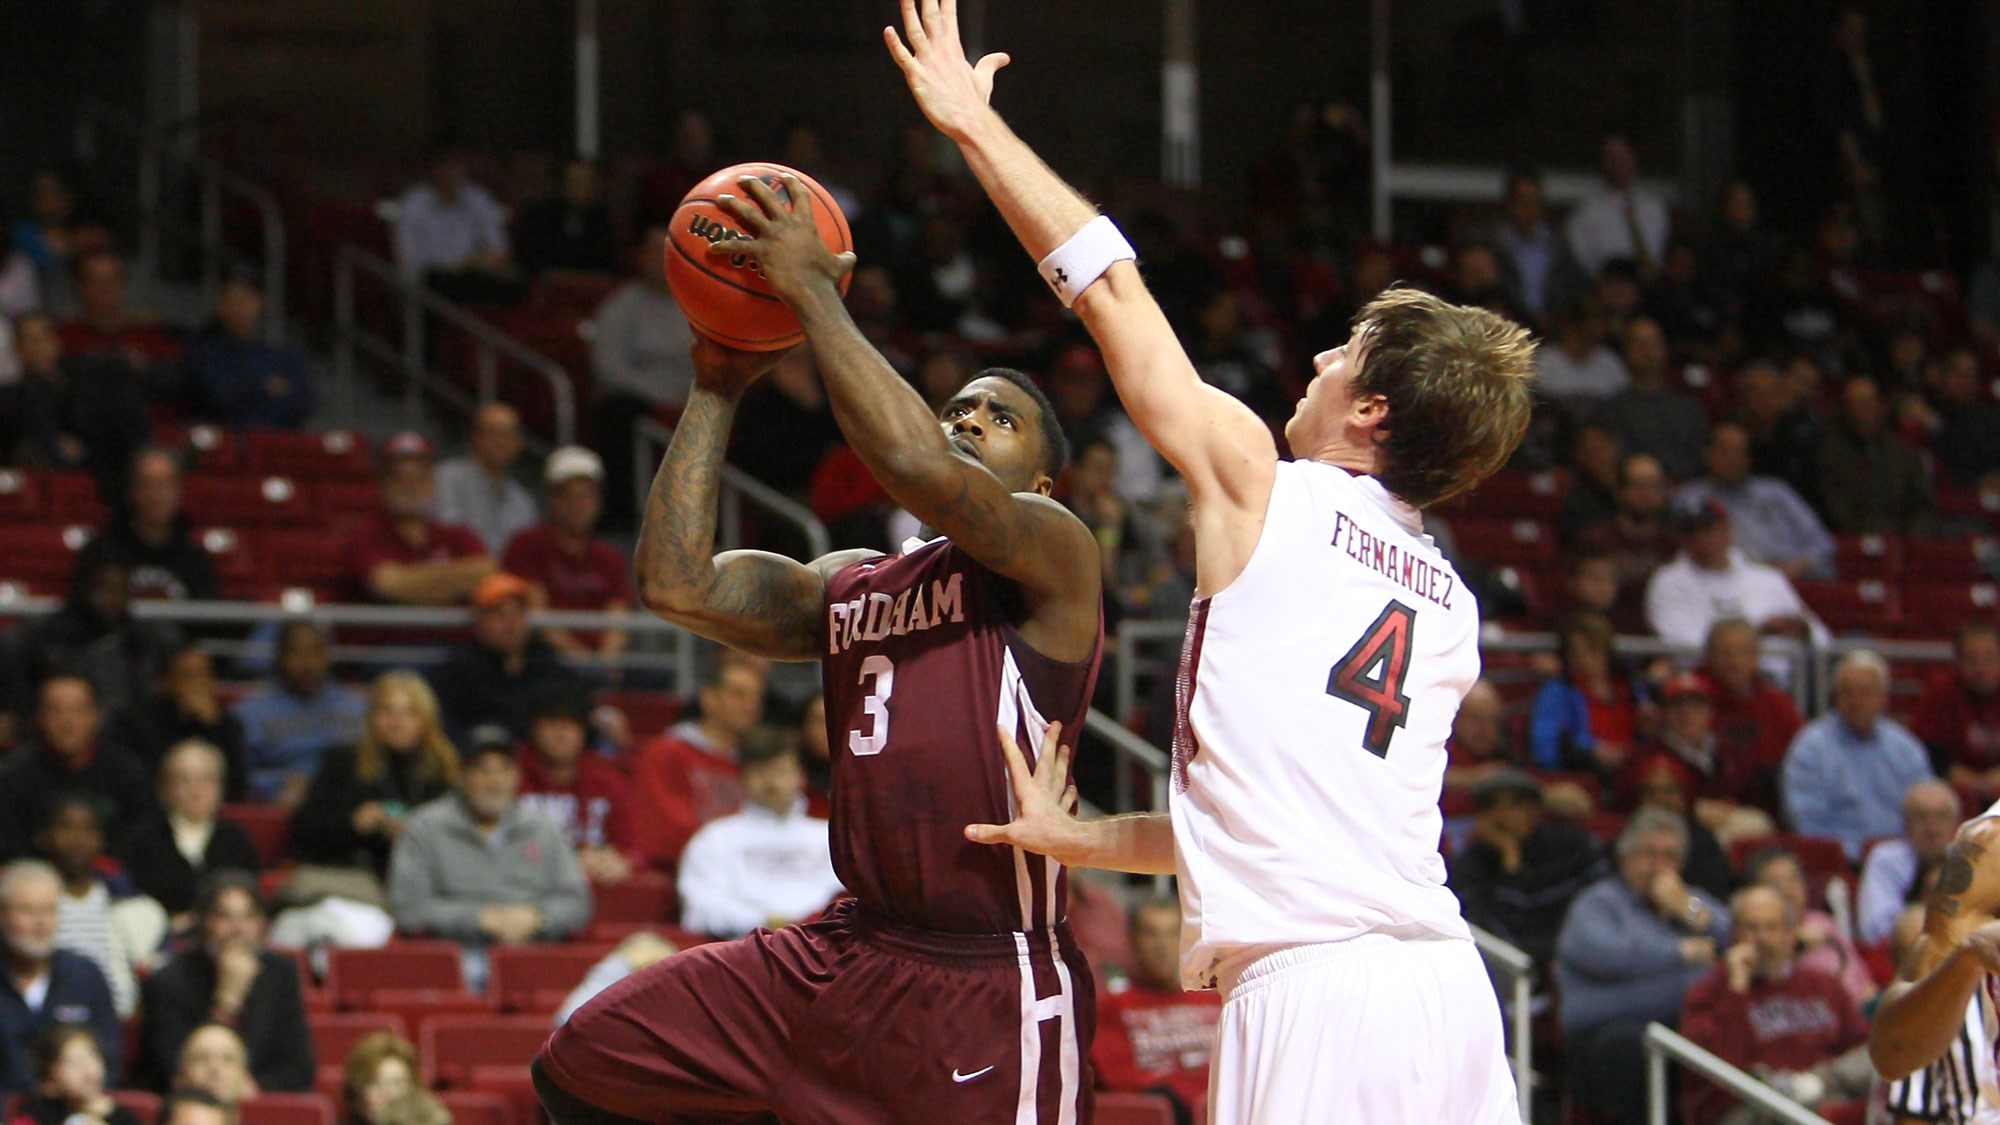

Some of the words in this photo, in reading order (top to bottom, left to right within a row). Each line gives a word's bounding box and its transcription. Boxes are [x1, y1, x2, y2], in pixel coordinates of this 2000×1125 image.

[1331, 510, 1454, 611] FERNANDEZ
[848, 655, 894, 756] 3
[1325, 598, 1417, 760] 4
